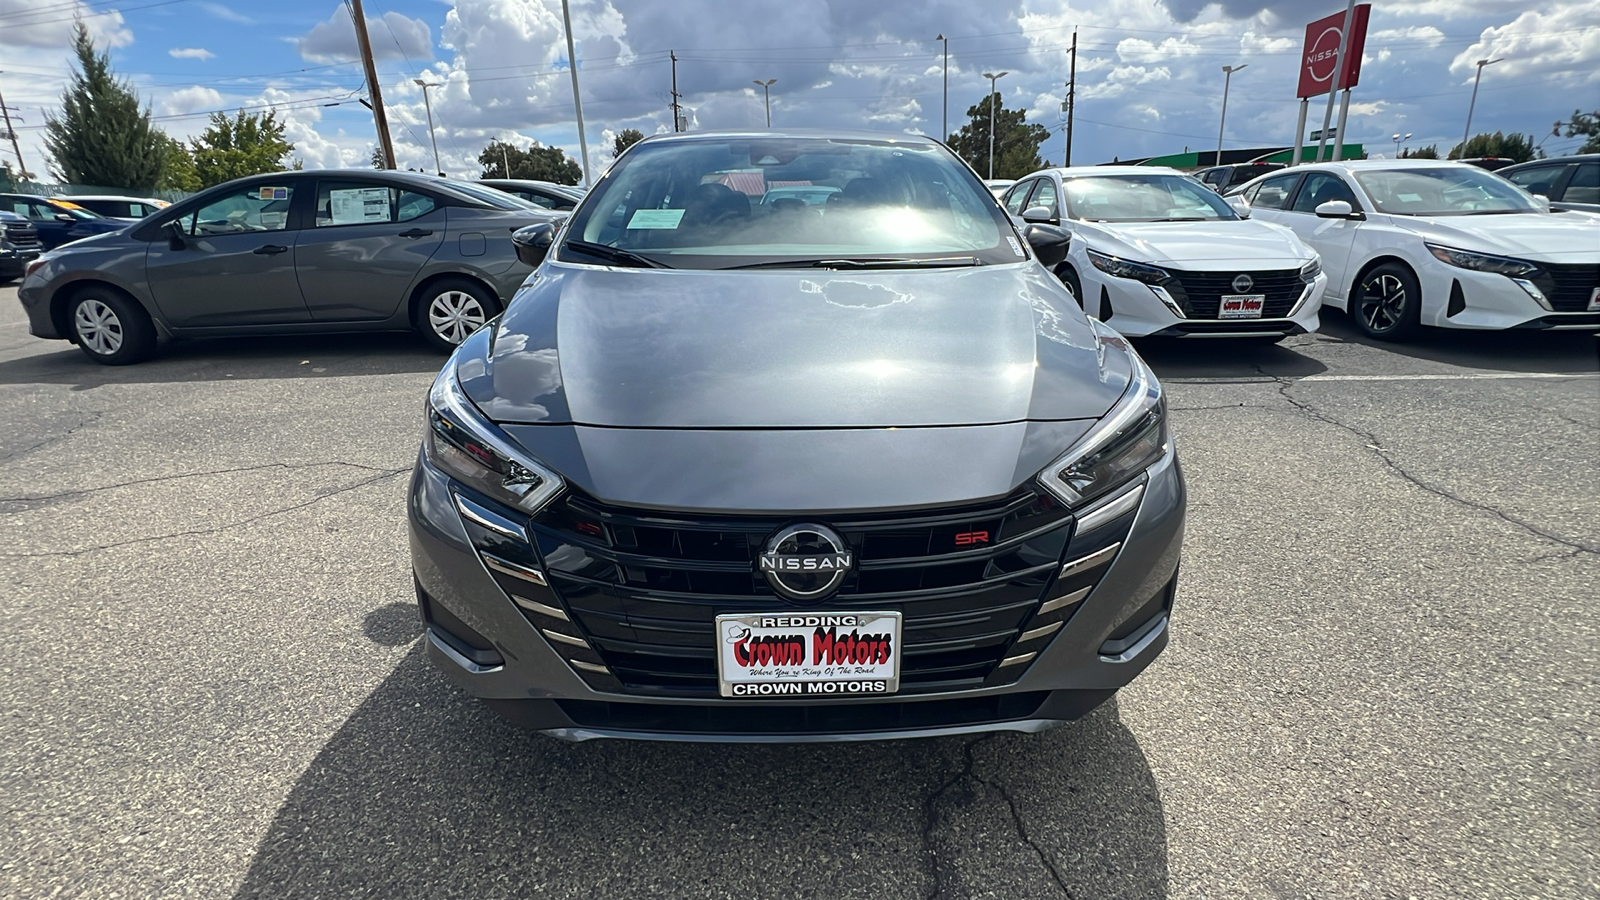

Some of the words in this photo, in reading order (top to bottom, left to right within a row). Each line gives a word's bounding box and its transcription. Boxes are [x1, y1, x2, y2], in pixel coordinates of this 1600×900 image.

[1306, 48, 1339, 64] NISSA
[955, 531, 989, 545] SR
[761, 555, 850, 570] NISSAN
[762, 616, 857, 627] REDDING
[733, 628, 806, 667] Crown
[813, 627, 892, 666] Motors
[749, 668, 773, 676] Where
[774, 668, 800, 678] You're
[802, 668, 821, 677] King
[824, 667, 835, 676] Of
[733, 683, 802, 695] CROWN
[807, 681, 885, 693] MOTORS
